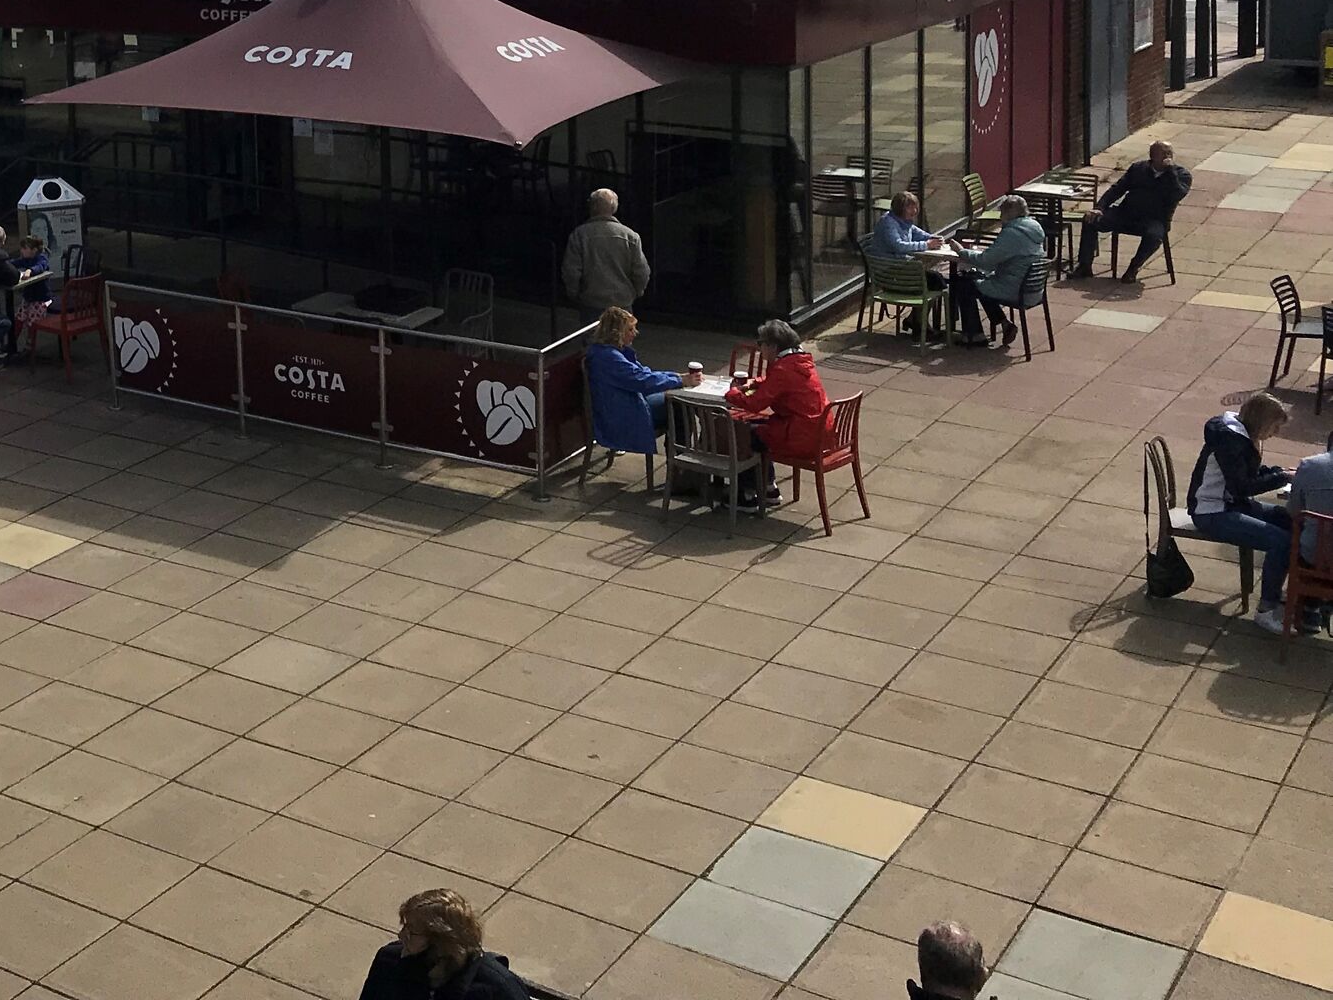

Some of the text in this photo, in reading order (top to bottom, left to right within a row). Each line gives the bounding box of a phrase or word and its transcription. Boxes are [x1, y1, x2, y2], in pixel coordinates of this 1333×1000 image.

[200, 9, 252, 21] COFFE
[244, 45, 353, 70] COSTA
[496, 36, 566, 62] COSTA
[274, 364, 346, 392] COSTA
[291, 389, 330, 403] COFFEE
